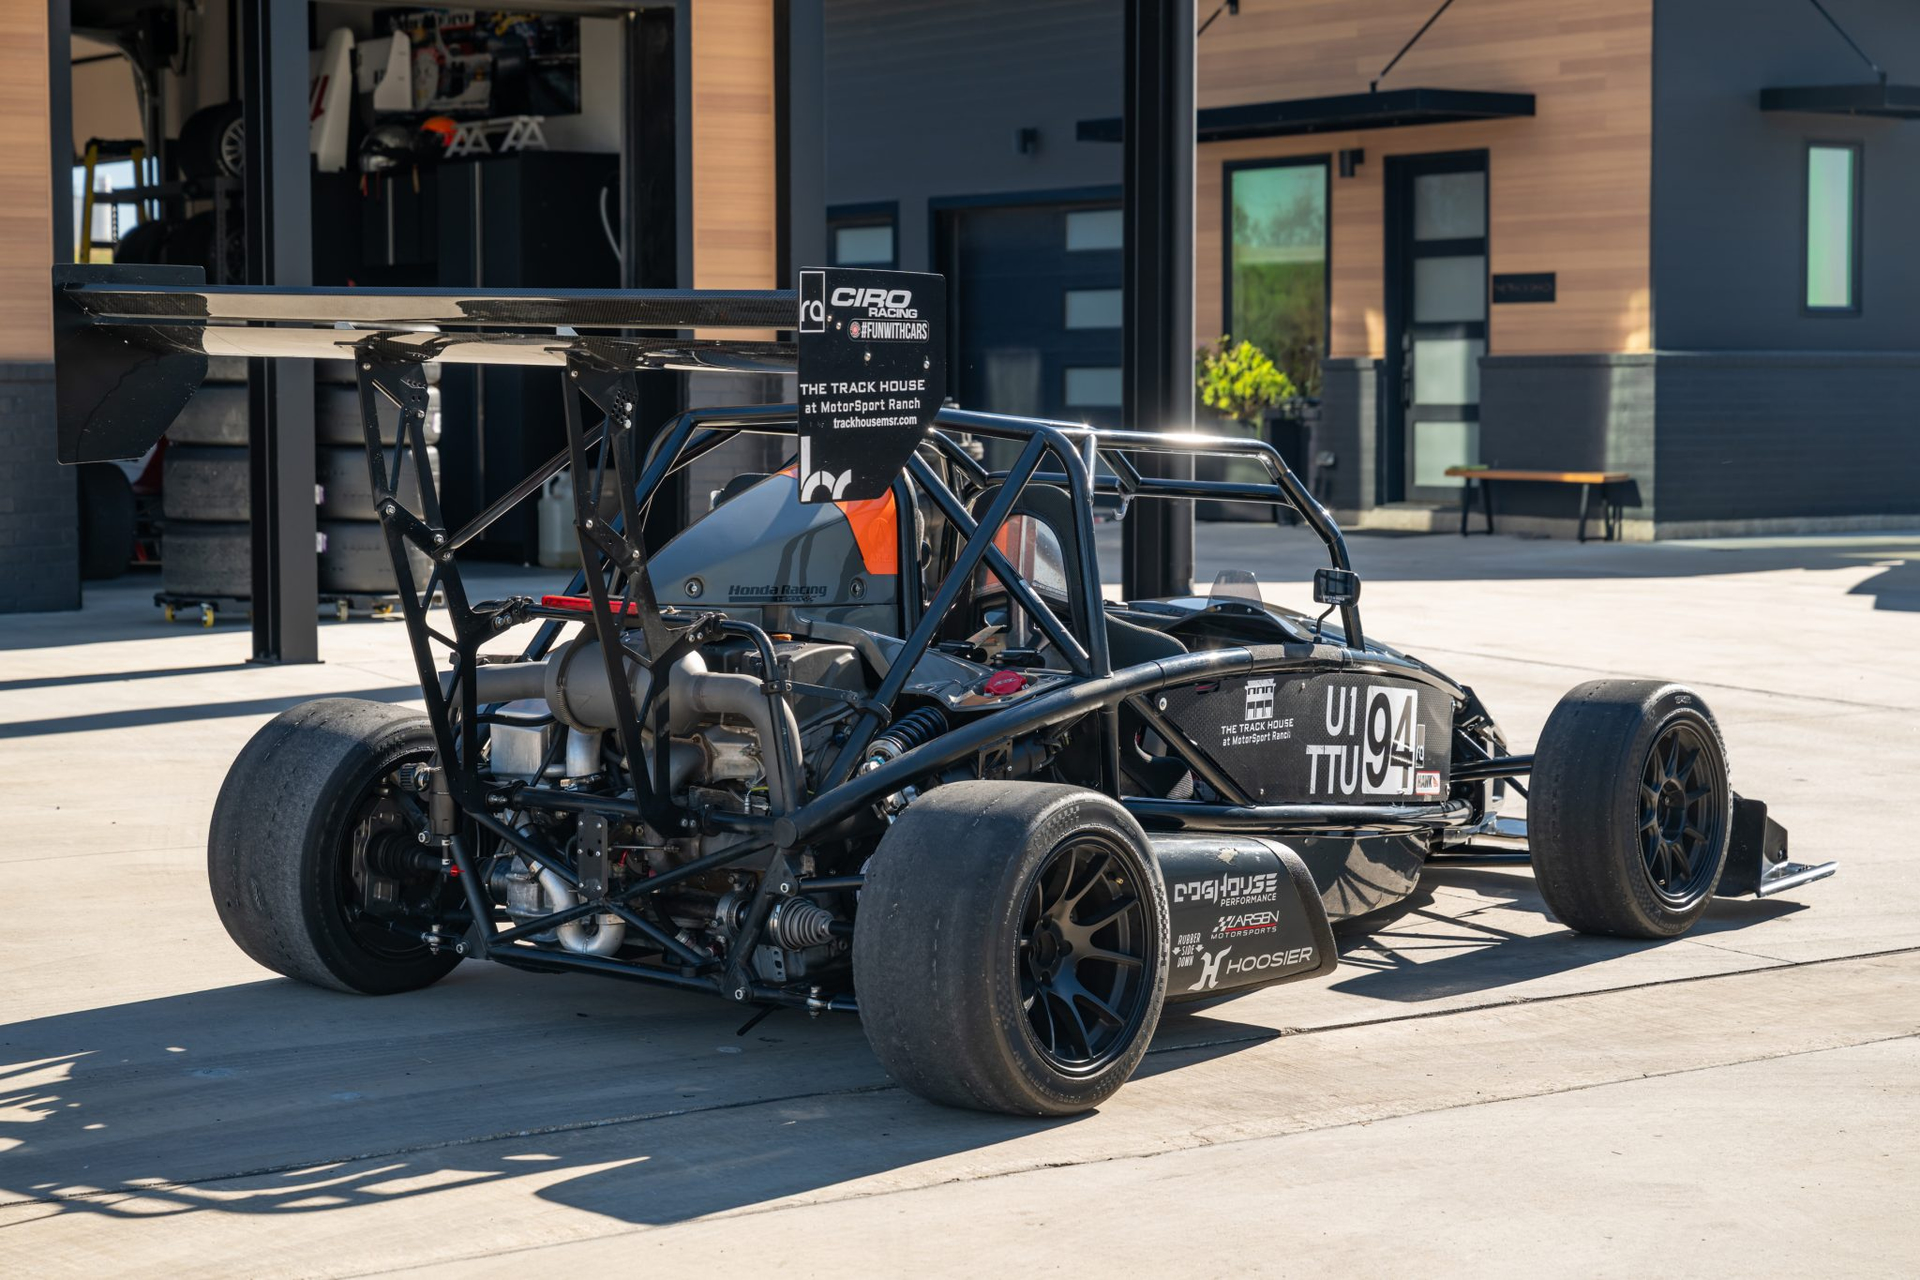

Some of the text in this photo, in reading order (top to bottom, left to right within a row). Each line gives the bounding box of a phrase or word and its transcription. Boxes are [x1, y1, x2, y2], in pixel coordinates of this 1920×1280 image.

[831, 288, 912, 308] CIRO
[868, 308, 918, 319] RACING
[861, 322, 928, 340] #FUNWITHCARS
[800, 380, 926, 396] THE TRACK HOUSE
[805, 398, 920, 414] at MotorSport Ranch
[833, 416, 918, 429] trackhousemsr.com
[728, 585, 827, 598] Honda Racing
[1221, 718, 1294, 734] THE TRACK HOUSE
[1222, 737, 1230, 746] at
[1232, 732, 1271, 745] MotorSport
[1366, 692, 1413, 789] 94
[1306, 745, 1359, 795] TTU
[1174, 872, 1278, 904] DOGHOUSE
[1220, 892, 1277, 907] PERFORMANCE
[1227, 910, 1280, 926] LARSEN
[1178, 932, 1202, 945] RUBBER
[1210, 926, 1277, 940] MOTORSPORTS
[1181, 944, 1195, 956] SIDE
[1176, 955, 1194, 968] DOWN
[1226, 946, 1313, 974] HOOSIER
